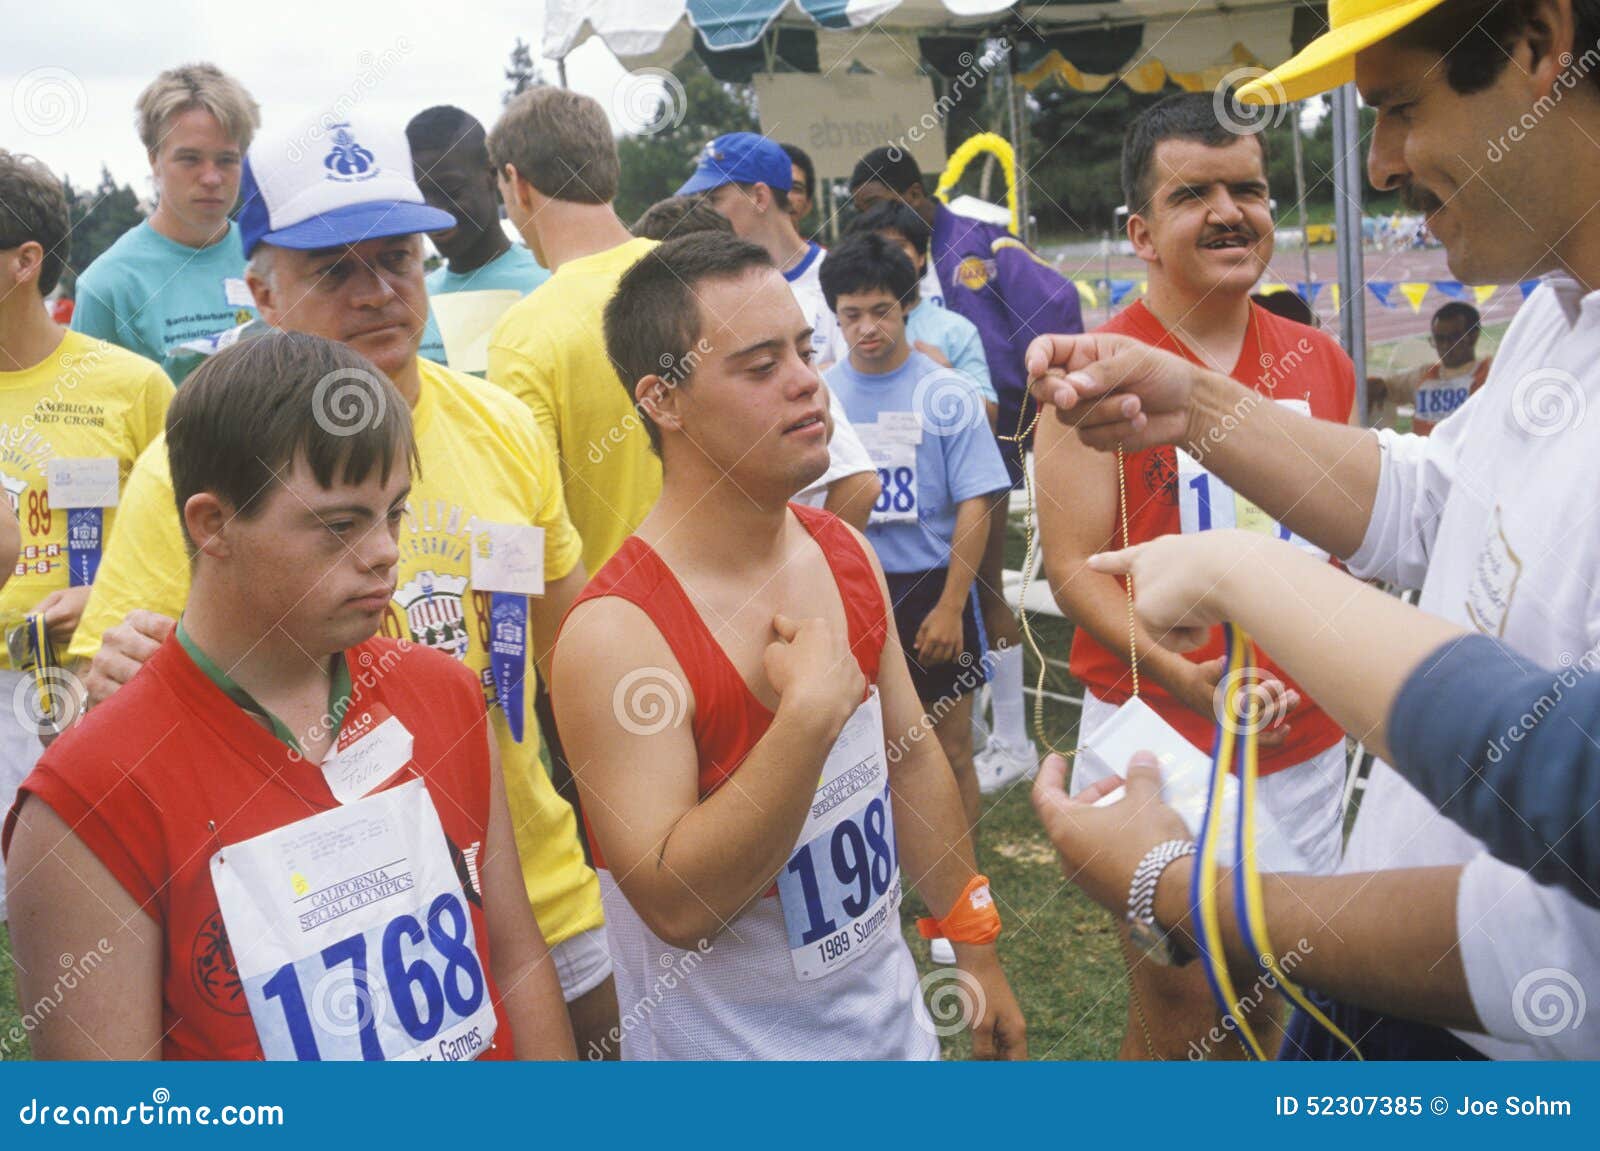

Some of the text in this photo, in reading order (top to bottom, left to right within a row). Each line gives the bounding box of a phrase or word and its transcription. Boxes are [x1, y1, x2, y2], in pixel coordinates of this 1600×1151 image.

[36, 402, 104, 415] AMERICAN
[1418, 387, 1468, 413] 1898
[34, 412, 105, 427] RED CROSS
[28, 489, 52, 536] 89
[340, 712, 373, 741] ELLO
[822, 762, 870, 800] CALIFORNIA
[811, 788, 848, 819] SPECIAL
[787, 783, 899, 946] 198
[300, 873, 414, 931] SPECIAL OLYMPICS
[311, 869, 390, 908] CALIFORNIA
[817, 931, 851, 963] 1989
[854, 902, 889, 945] Summer
[262, 893, 484, 1061] 1768
[439, 1026, 482, 1062] Games
